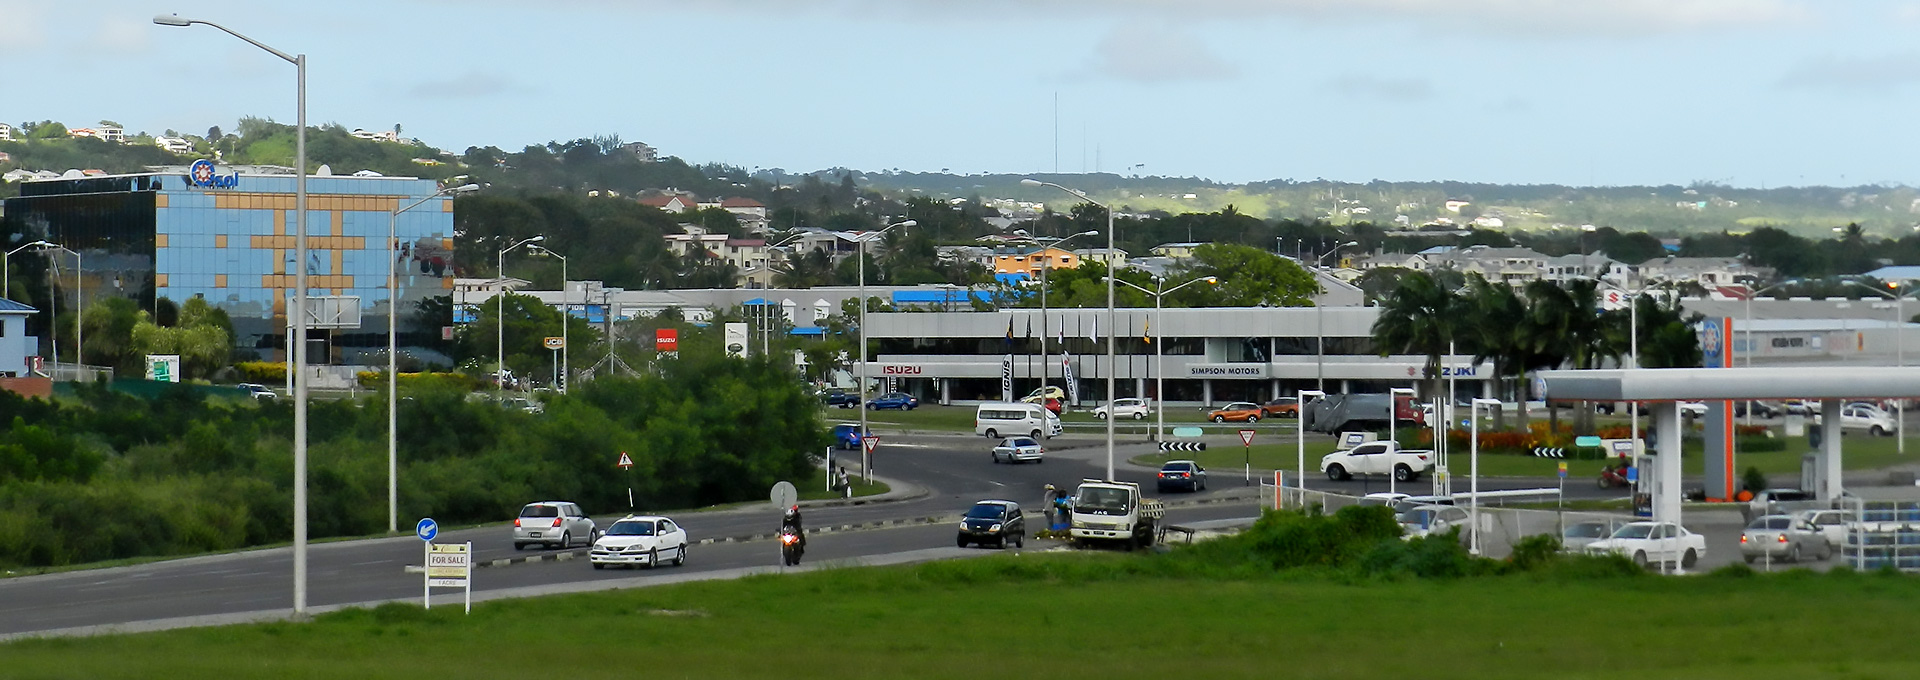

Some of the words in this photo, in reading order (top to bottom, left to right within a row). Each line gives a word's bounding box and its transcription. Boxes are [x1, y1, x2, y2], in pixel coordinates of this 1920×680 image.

[214, 172, 239, 187] sol
[883, 366, 921, 374] ISUZU
[1191, 367, 1226, 375] SIMPSON
[1228, 367, 1260, 375] MOTORS
[432, 556, 446, 564] FOR
[448, 556, 465, 564] SALE
